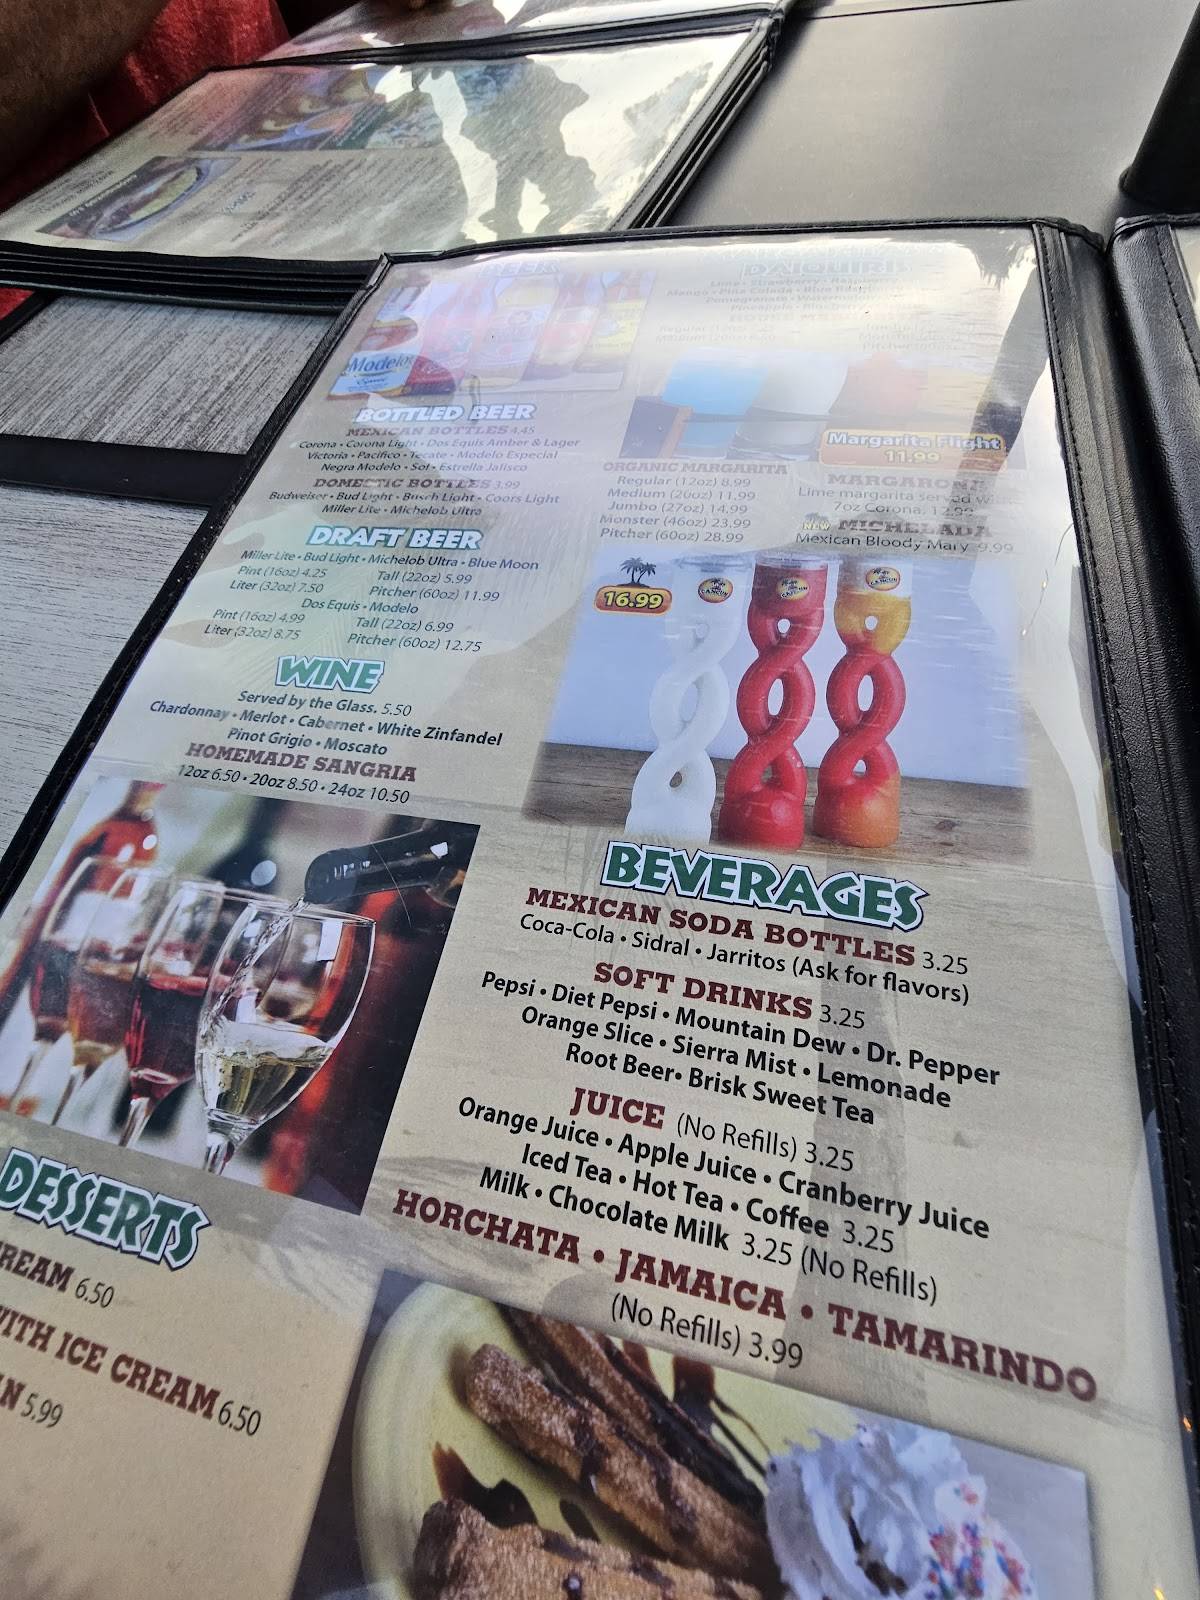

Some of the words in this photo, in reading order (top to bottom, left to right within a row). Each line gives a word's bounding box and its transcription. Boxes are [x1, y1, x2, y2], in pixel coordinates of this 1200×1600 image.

[354, 406, 463, 422] BOTTLED
[469, 404, 537, 421] BEER
[828, 431, 931, 449] Margarita
[936, 434, 1001, 451] Flight
[321, 463, 354, 473] Negra
[356, 463, 401, 472] Modelo
[410, 463, 430, 471] Sol
[602, 461, 679, 473] ORGANIC
[680, 462, 788, 475] MARGARITA
[884, 449, 941, 464] 11.99
[407, 478, 491, 489] BOTTLES
[617, 475, 673, 487] Regular
[321, 504, 357, 513] Miller
[357, 504, 381, 514] Lite
[389, 504, 448, 515] Michelob
[451, 505, 482, 516] Ultra
[607, 500, 658, 512] Jumbo
[599, 514, 661, 526] Monster
[711, 517, 751, 529] 23.99
[599, 527, 653, 540] Pitcher
[655, 528, 700, 542] (60oz)
[703, 531, 745, 543] 28.99
[306, 525, 406, 548] DRAFT
[408, 527, 484, 550] BEER
[796, 532, 861, 547] Mexican
[866, 534, 921, 552] Bloody
[927, 538, 969, 554] Mary
[240, 550, 272, 560] Miller
[274, 551, 296, 561] Lite
[303, 551, 328, 562] Bud
[330, 552, 360, 564] Light
[368, 554, 426, 566] Michelob
[427, 555, 458, 567] Ultra
[467, 557, 497, 569] Blue
[500, 559, 539, 571] Moon
[377, 570, 400, 581] Tall
[443, 573, 473, 584] 5.99
[301, 597, 325, 609] Dos
[326, 599, 361, 613] Equis
[368, 601, 419, 614] Modelo
[369, 585, 417, 598] Pitcher
[419, 588, 460, 601] (60oz)
[463, 590, 500, 602] 11.99
[603, 591, 663, 609] 16.99
[355, 616, 379, 629] Tall
[381, 618, 422, 632] (22oz)
[424, 621, 454, 634] 6.99
[346, 632, 397, 647] Pitcher
[398, 636, 441, 650] (60oz)
[444, 638, 483, 652] 12.75
[275, 655, 385, 694] WINE
[236, 690, 288, 707] Served
[288, 693, 307, 711] by
[308, 696, 333, 710] the
[335, 698, 378, 714] Glass.
[380, 702, 413, 717] 5.50
[149, 699, 231, 722] Chardonnay
[238, 709, 287, 725] Merlot
[297, 714, 366, 733] Cabernet
[376, 721, 422, 739] White
[423, 726, 503, 747] Zinfandel
[226, 727, 267, 743] Pinot
[268, 730, 313, 750] Grigio
[323, 736, 388, 756] Moscato
[184, 742, 311, 770] HOMEMADE
[312, 755, 417, 783] SANGRIA
[178, 764, 212, 780] 12oz
[211, 768, 241, 783] 6.50
[249, 772, 284, 789] 20oz
[286, 777, 319, 793] 8.50
[327, 781, 366, 800] 24oz
[370, 786, 410, 805] 10.50
[600, 840, 930, 932] BEVERAGES
[525, 886, 662, 925] MEXICAN
[668, 908, 755, 941] SODA
[763, 922, 916, 967] BOTTLES
[922, 950, 969, 976] 3.25
[519, 913, 615, 945] Coca-Cola
[631, 930, 690, 957] Sidral
[706, 942, 787, 972] Jarritos
[792, 955, 839, 982] (Ask
[844, 963, 878, 988] for
[882, 970, 970, 1008] flavors)
[593, 961, 676, 995] SOFT
[682, 975, 813, 1021] DRINKS
[818, 1003, 866, 1030] 3.25
[481, 970, 537, 998] Pepsi
[551, 982, 596, 1009] Diet
[599, 991, 659, 1022] Pepsi
[674, 1005, 787, 1045] Mountain
[792, 1026, 847, 1057] Dew
[866, 1041, 902, 1067] Dr.
[908, 1048, 1001, 1087] Pepper
[520, 1004, 600, 1040] Orange
[603, 1020, 655, 1049] Slice
[671, 1034, 740, 1067] Sierra
[744, 1047, 797, 1078] Mist
[817, 1061, 953, 1109] Lemonade
[565, 1041, 619, 1072] Root
[622, 1052, 676, 1083] Beer
[688, 1066, 748, 1100] Brisk
[751, 1079, 827, 1116] Sweet
[831, 1095, 875, 1126] Tea
[569, 1086, 667, 1131] JUICE
[676, 1111, 716, 1142] (No
[721, 1121, 798, 1164] Refills)
[804, 1141, 855, 1172] 3.25
[458, 1095, 539, 1136] Orange
[541, 1115, 600, 1148] Juice
[617, 1132, 689, 1169] Apple
[693, 1149, 758, 1185] Juice
[778, 1168, 913, 1228] Cranberry
[918, 1200, 991, 1240] Juice
[0, 1146, 212, 1272] DESSERTS
[520, 1142, 571, 1176] Iced
[573, 1154, 614, 1186] Tea
[632, 1168, 678, 1202] Hot
[682, 1180, 724, 1214] Tea
[745, 1196, 831, 1240] Coffee
[841, 1218, 896, 1255] 3.25
[479, 1165, 532, 1200] Milk
[548, 1182, 669, 1236] Chocolate
[672, 1213, 731, 1253] Milk
[741, 1230, 794, 1267] 3.25
[800, 1243, 846, 1281] (No
[852, 1256, 938, 1310] Refills)
[0, 1242, 76, 1294] REAM
[74, 1276, 116, 1310] 6.50
[391, 1187, 581, 1265] HORCHATA
[613, 1247, 788, 1322] JAMAICA
[827, 1301, 1098, 1403] TAMARINDO
[611, 1291, 653, 1328] (No
[659, 1303, 742, 1358] Refills)
[748, 1330, 804, 1370] 3.99
[53, 1330, 109, 1376] ICE
[109, 1352, 222, 1422] CREAM
[218, 1398, 262, 1437] 6.50
[20, 1391, 65, 1429] 5.99
